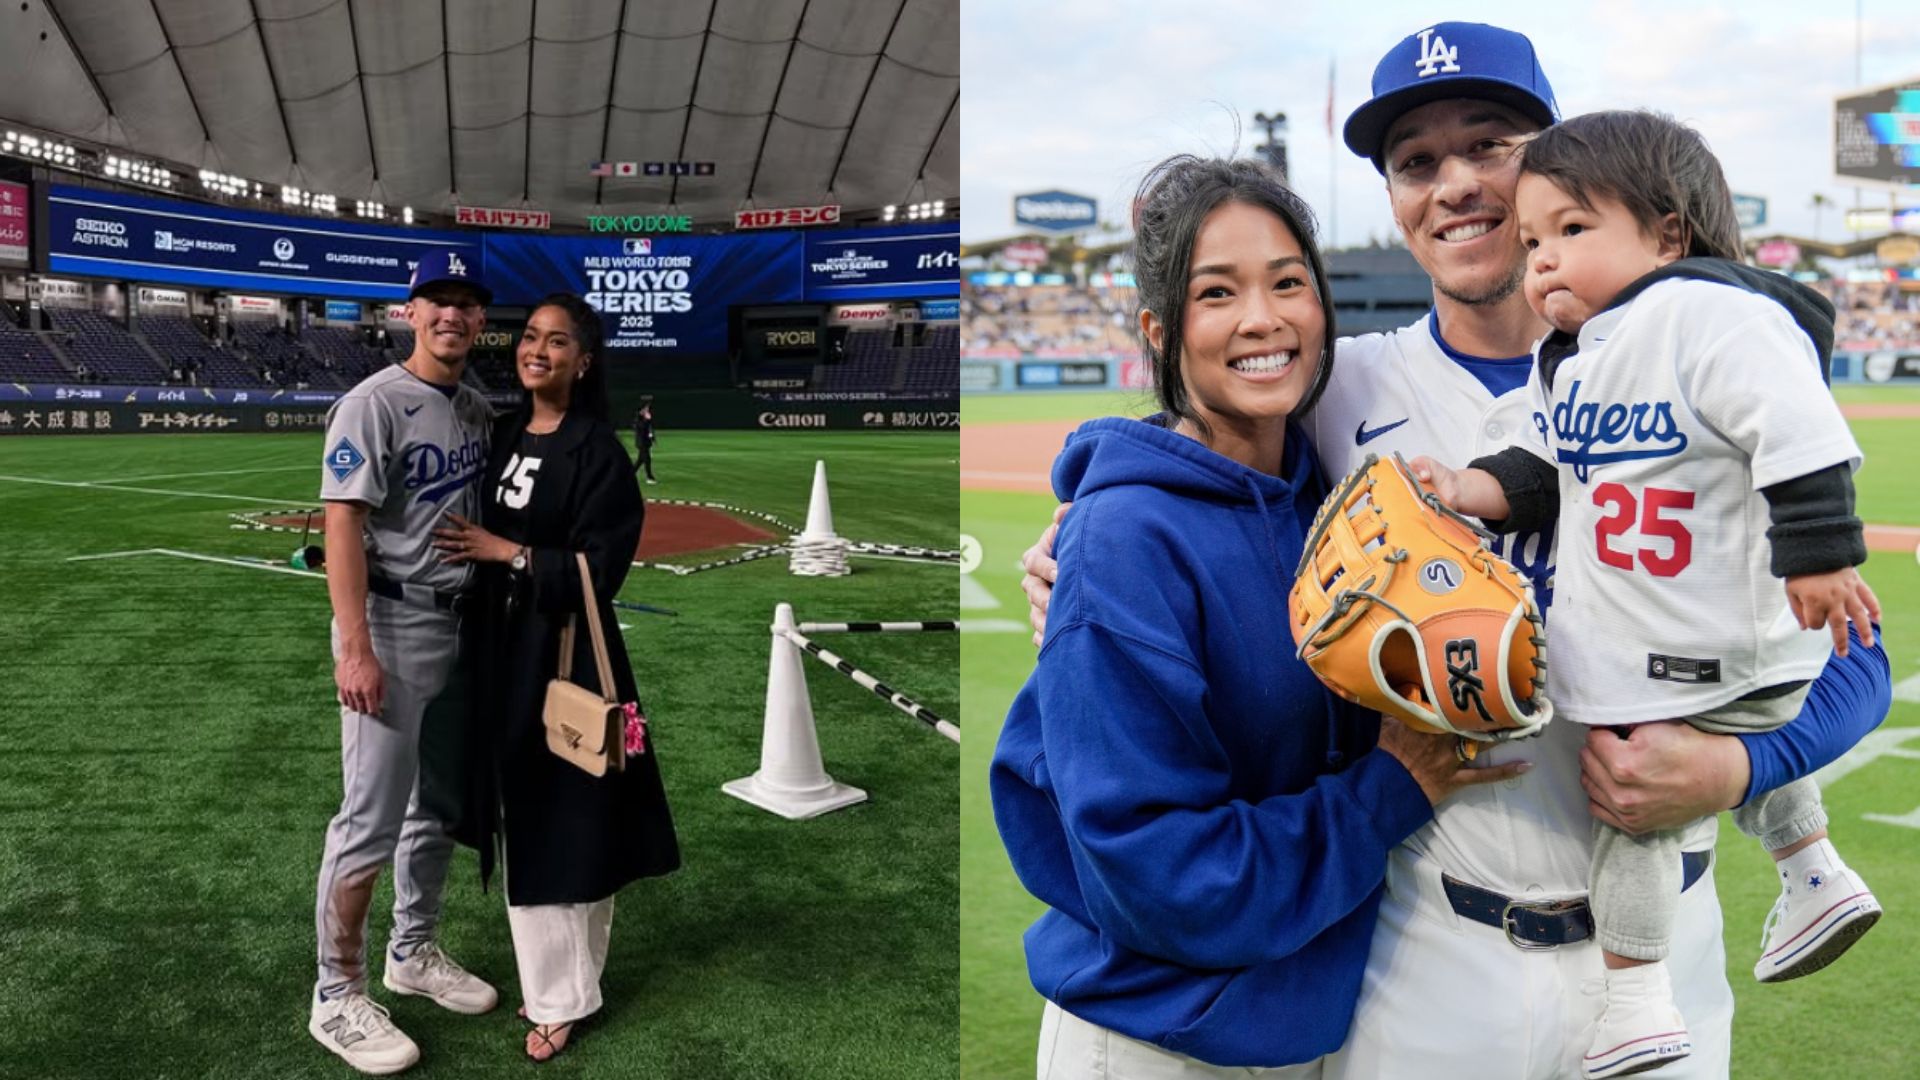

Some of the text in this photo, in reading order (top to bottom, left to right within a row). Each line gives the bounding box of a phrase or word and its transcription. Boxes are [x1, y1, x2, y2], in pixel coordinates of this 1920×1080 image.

[1415, 29, 1461, 78] LA
[587, 215, 693, 232] TOKYO DOME
[738, 206, 838, 226] オロナミンC
[75, 218, 126, 234] SEIKO
[72, 231, 129, 248] ASTRON
[195, 240, 237, 253] RESORTS
[325, 252, 398, 267] GUGGENHEIM
[448, 252, 467, 276] LA
[584, 256, 692, 268] MLB WORLD TOUR
[810, 262, 848, 273] TOKYO
[849, 259, 889, 270] SERIES
[586, 269, 690, 292] TOKYO
[584, 291, 693, 313] SERIES
[620, 315, 653, 328] 2025
[839, 308, 886, 320] Denyo
[767, 331, 816, 346] RYOBI
[22, 409, 112, 429] 大成建設
[137, 411, 238, 428] アートネイチャー
[758, 411, 827, 427] Canon
[892, 411, 960, 427] 積水ハウス
[1592, 481, 1696, 578] 25
